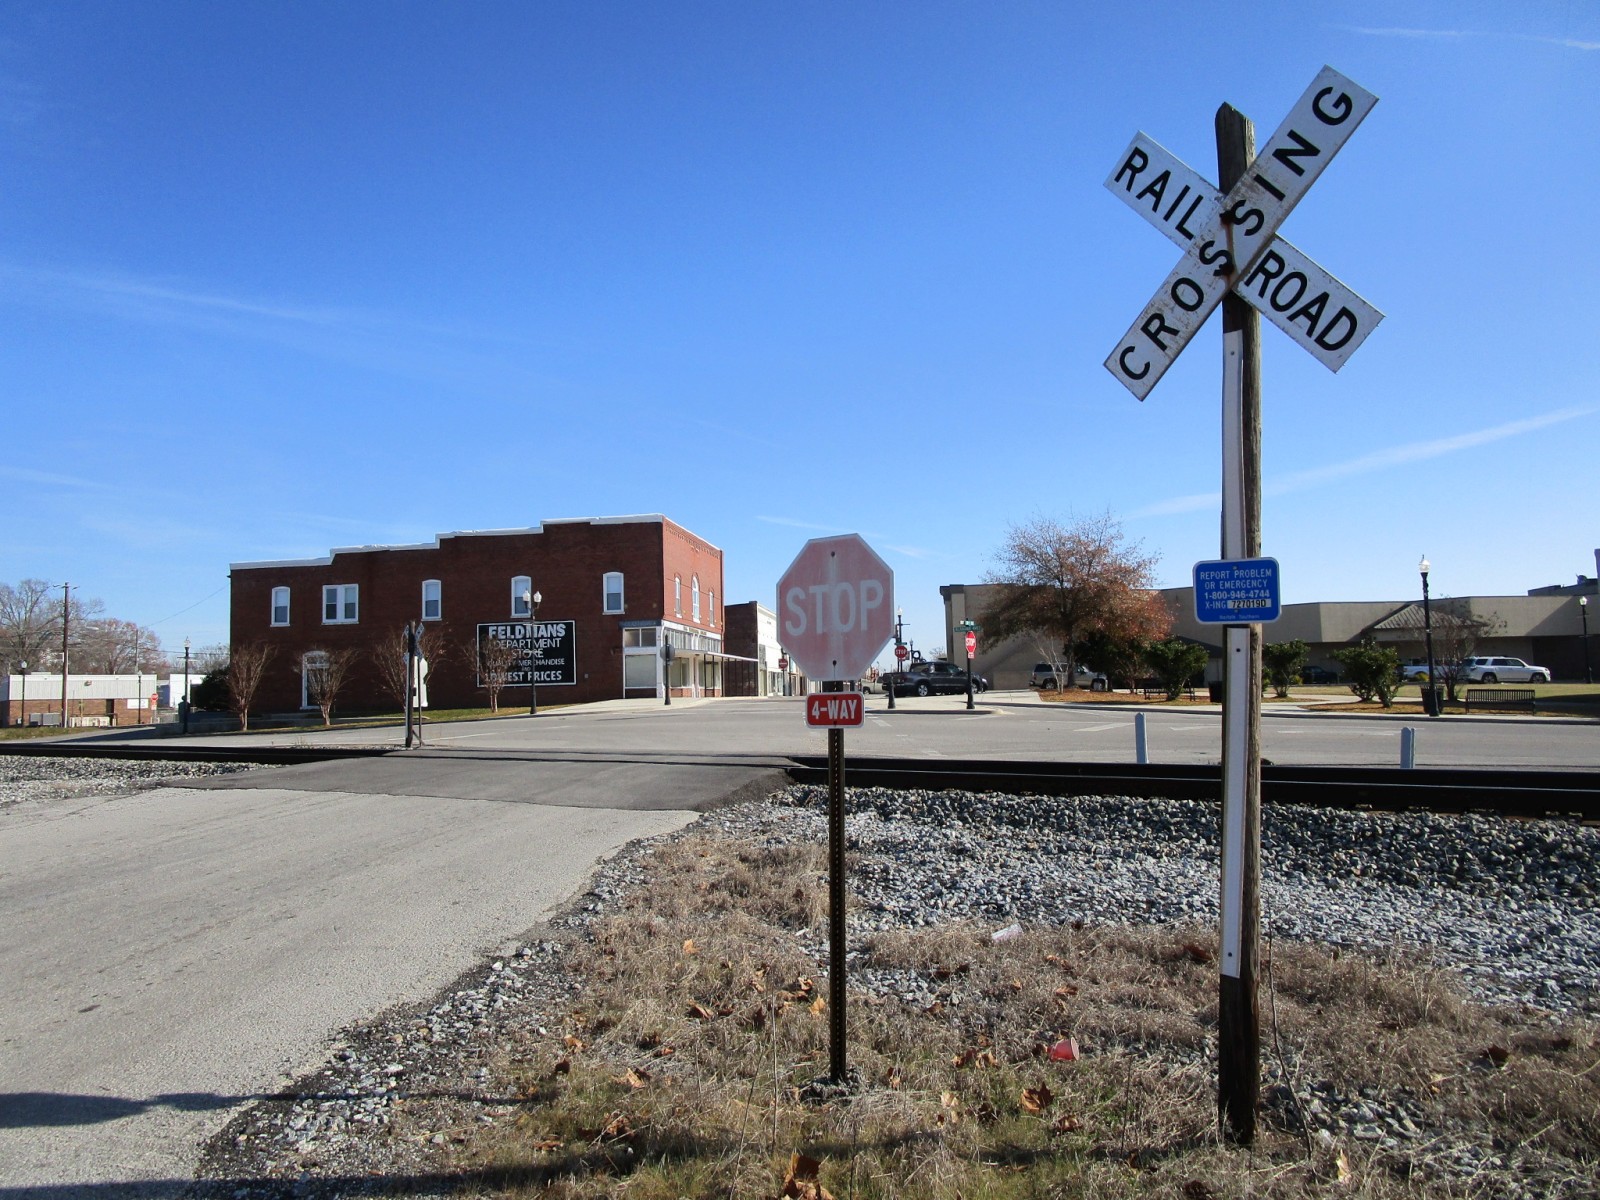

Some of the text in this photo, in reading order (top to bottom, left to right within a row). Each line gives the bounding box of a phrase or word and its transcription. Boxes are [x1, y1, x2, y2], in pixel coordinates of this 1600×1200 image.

[1118, 86, 1354, 381] CROSSING
[1200, 568, 1272, 580] REPORT PROBLEM
[1204, 580, 1268, 590] OR EMERGENCY
[1204, 590, 1270, 599] 1-800-946-4744
[785, 579, 884, 637] STOP
[1205, 600, 1226, 609] X-ING
[495, 638, 561, 648] DEPARTMENT
[512, 649, 544, 658] STORE
[812, 699, 858, 720] 4-WAY
